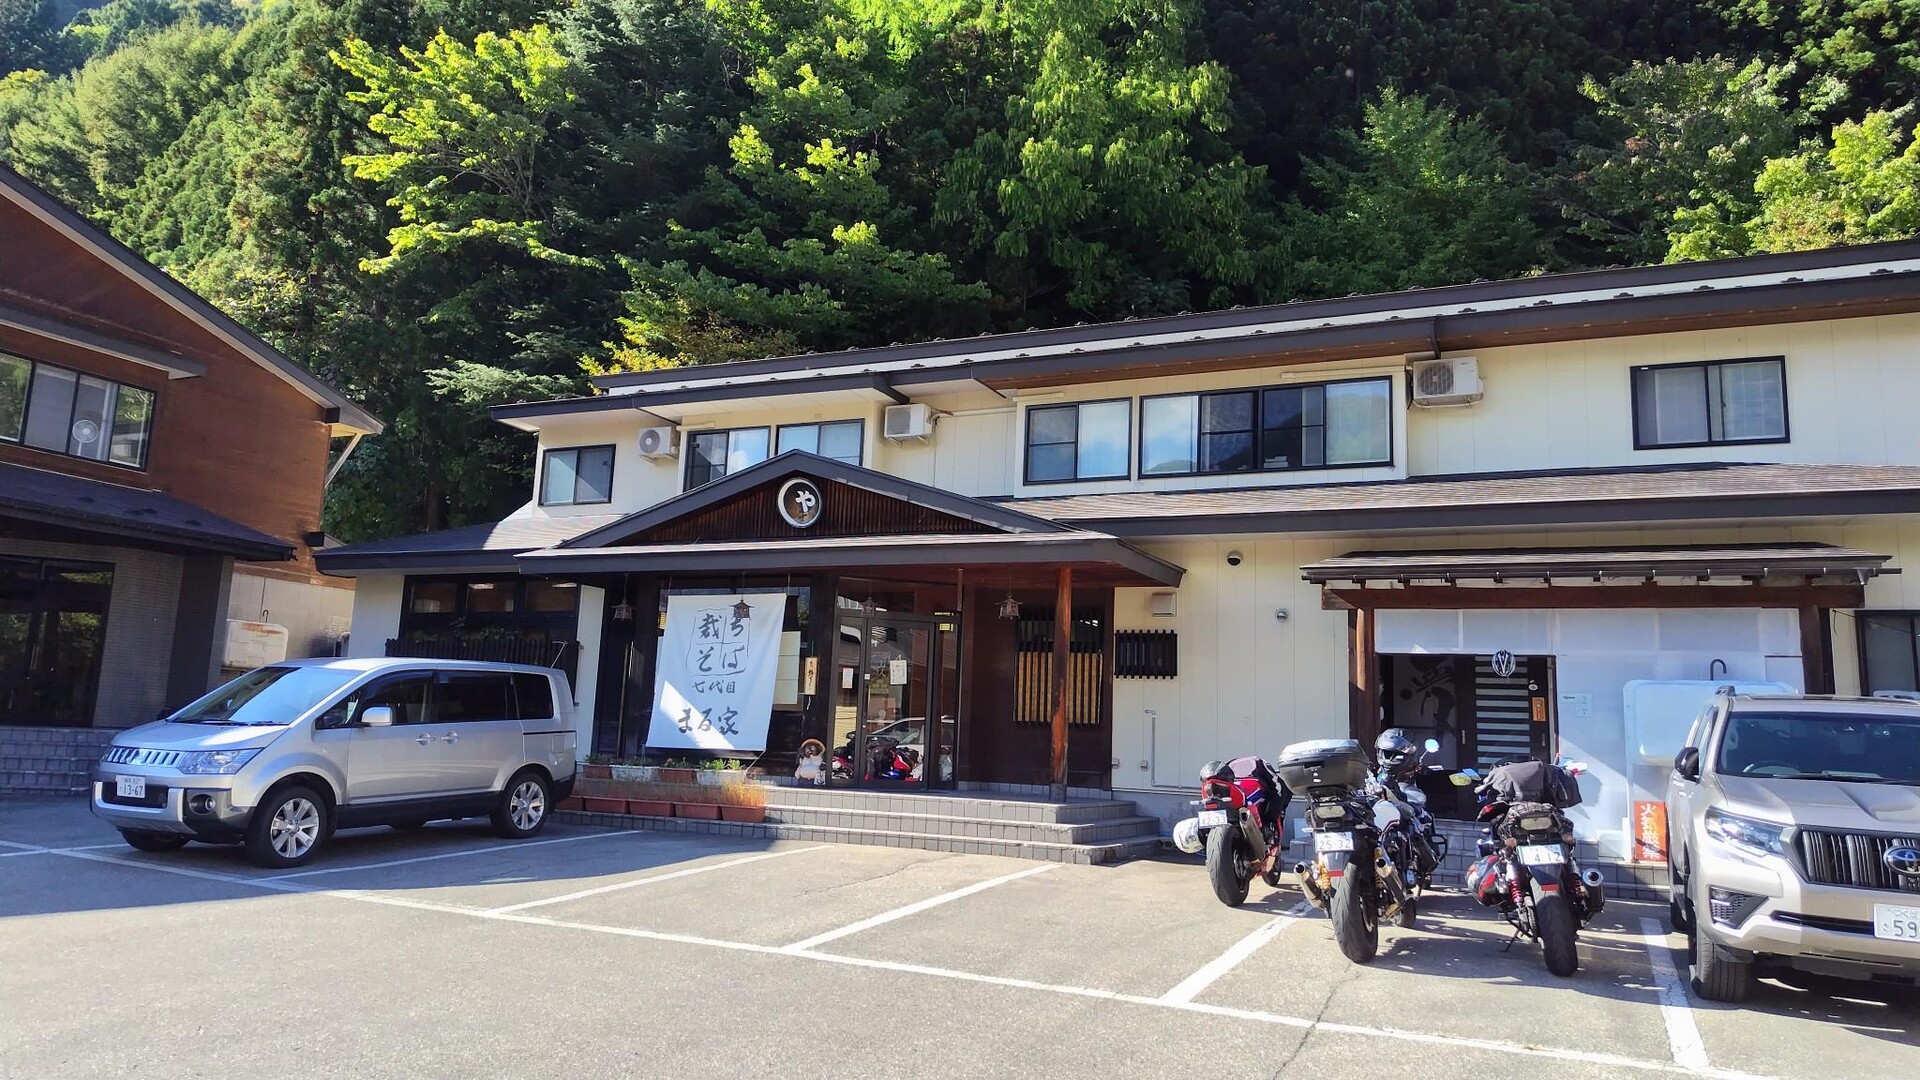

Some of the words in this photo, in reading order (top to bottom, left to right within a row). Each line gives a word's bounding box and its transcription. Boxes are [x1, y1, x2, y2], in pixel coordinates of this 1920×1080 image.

[696, 645, 745, 671] そば
[691, 680, 737, 694] 七代目
[678, 706, 740, 736] まる家
[123, 784, 143, 796] 13-67
[1319, 839, 1351, 850] 25-32
